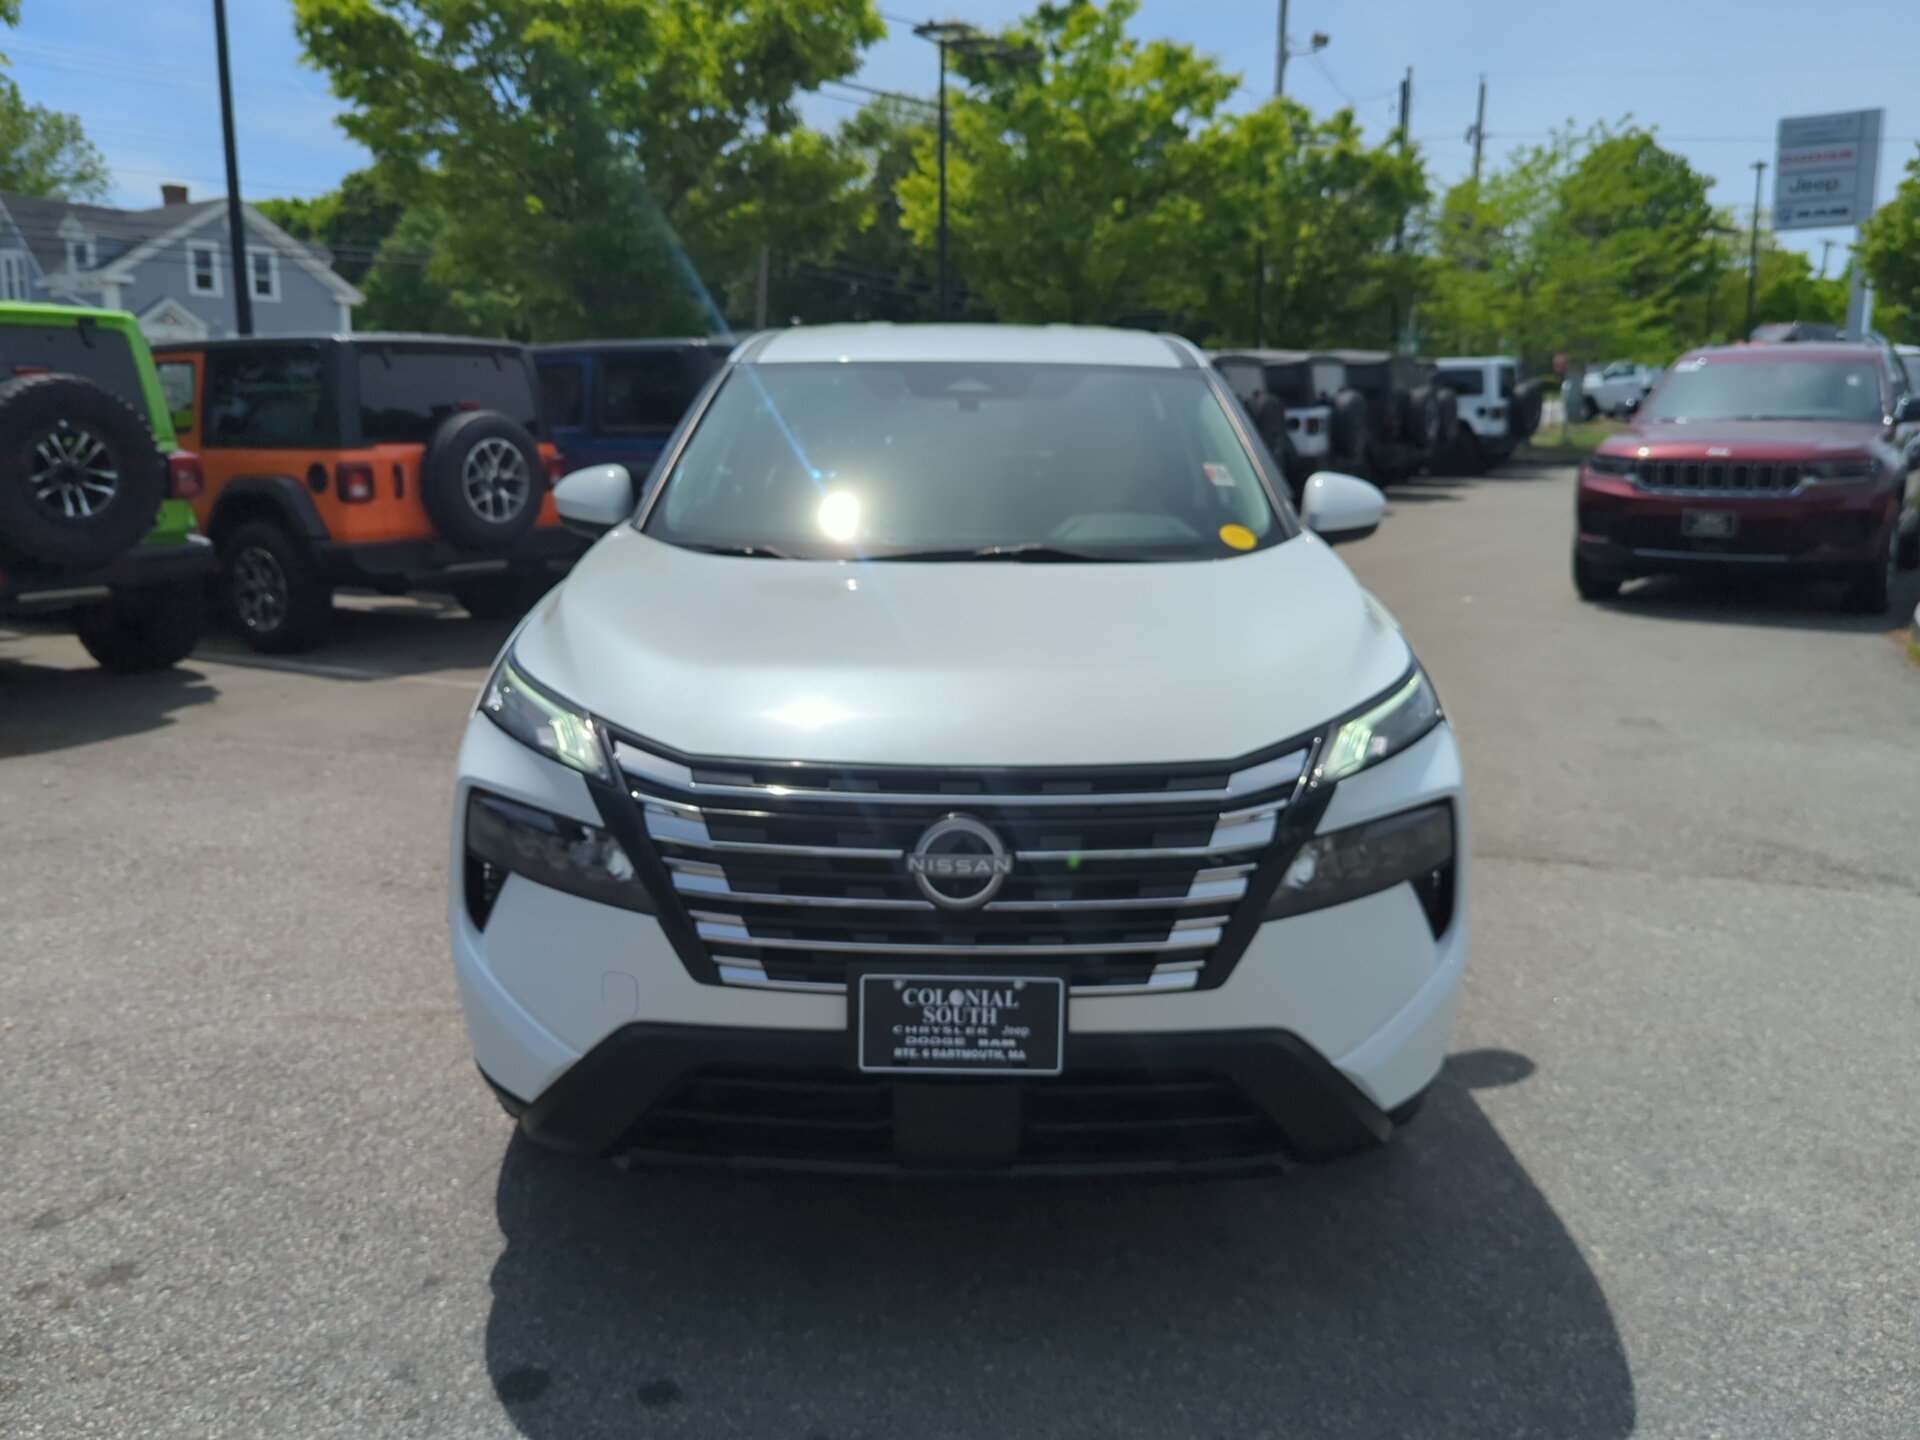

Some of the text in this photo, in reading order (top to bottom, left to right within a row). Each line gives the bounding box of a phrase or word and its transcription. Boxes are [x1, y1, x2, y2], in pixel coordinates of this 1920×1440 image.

[907, 857, 1012, 874] NISSAN
[902, 988, 1020, 1008] COLONIAL
[922, 1006, 997, 1026] SOUTH
[892, 1024, 989, 1036] CHRYSLER
[905, 1036, 966, 1047] DODGE
[893, 1047, 920, 1060] RTE.
[1008, 1049, 1027, 1060] MA
